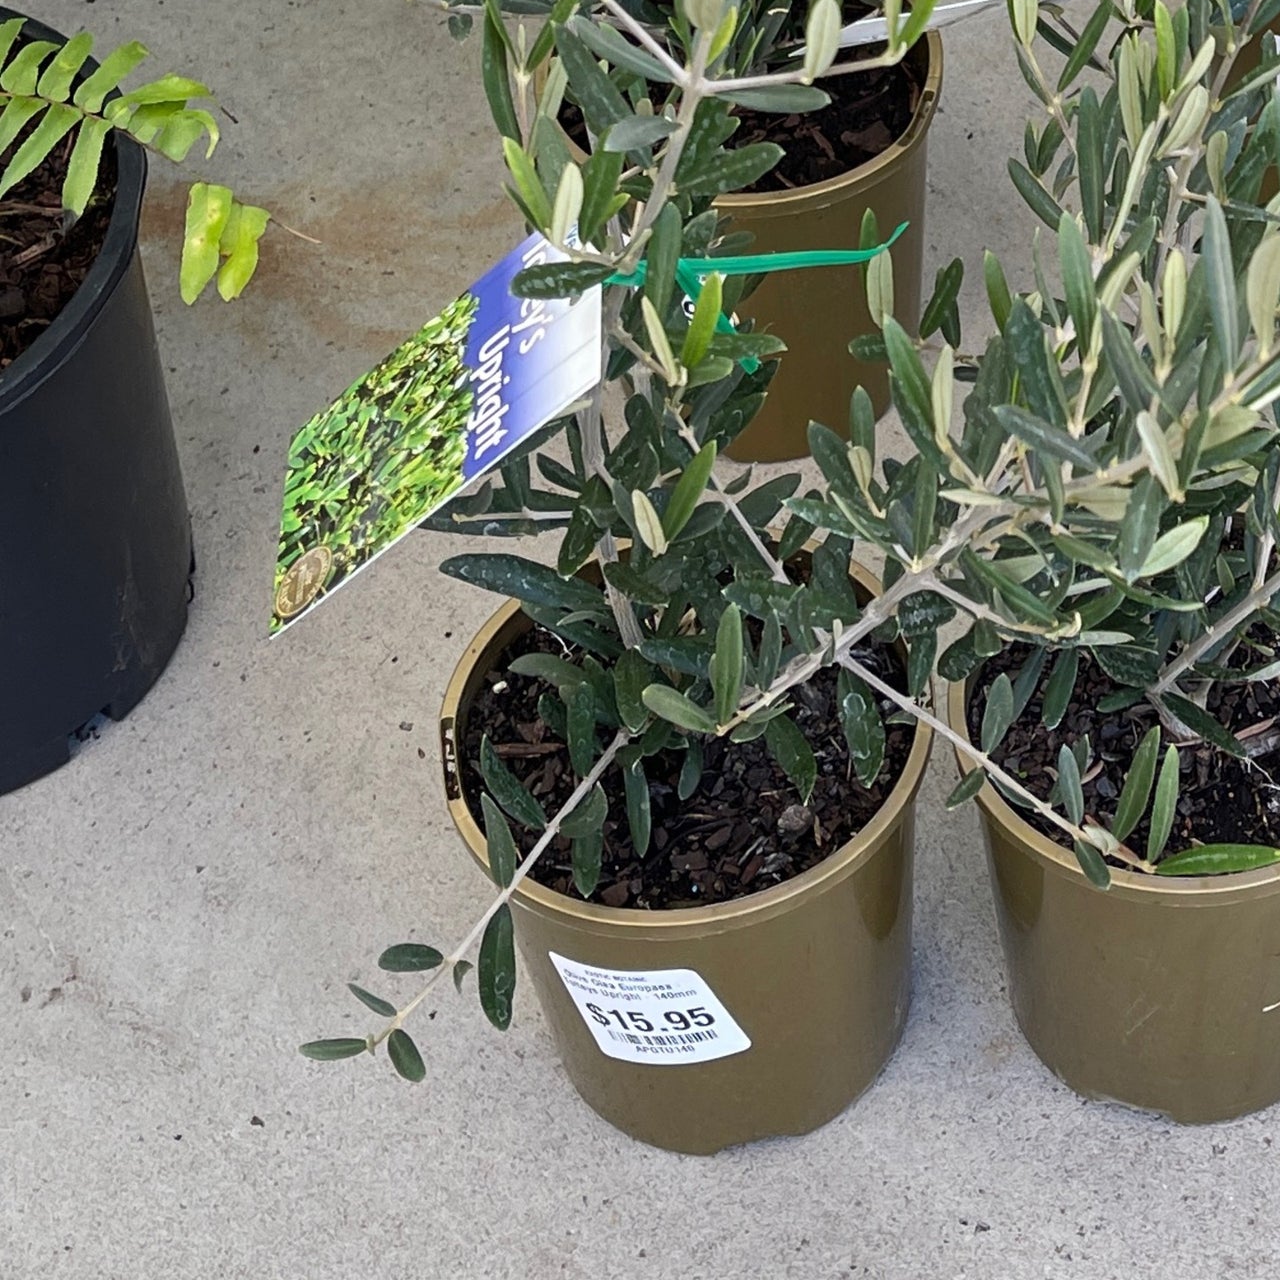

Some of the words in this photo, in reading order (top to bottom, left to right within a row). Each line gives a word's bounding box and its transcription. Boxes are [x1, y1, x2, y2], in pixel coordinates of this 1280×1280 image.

[467, 324, 510, 460] Upright
[600, 989, 642, 1001] Upright
[654, 989, 697, 1000] 140mm
[585, 1002, 715, 1032] $15.95
